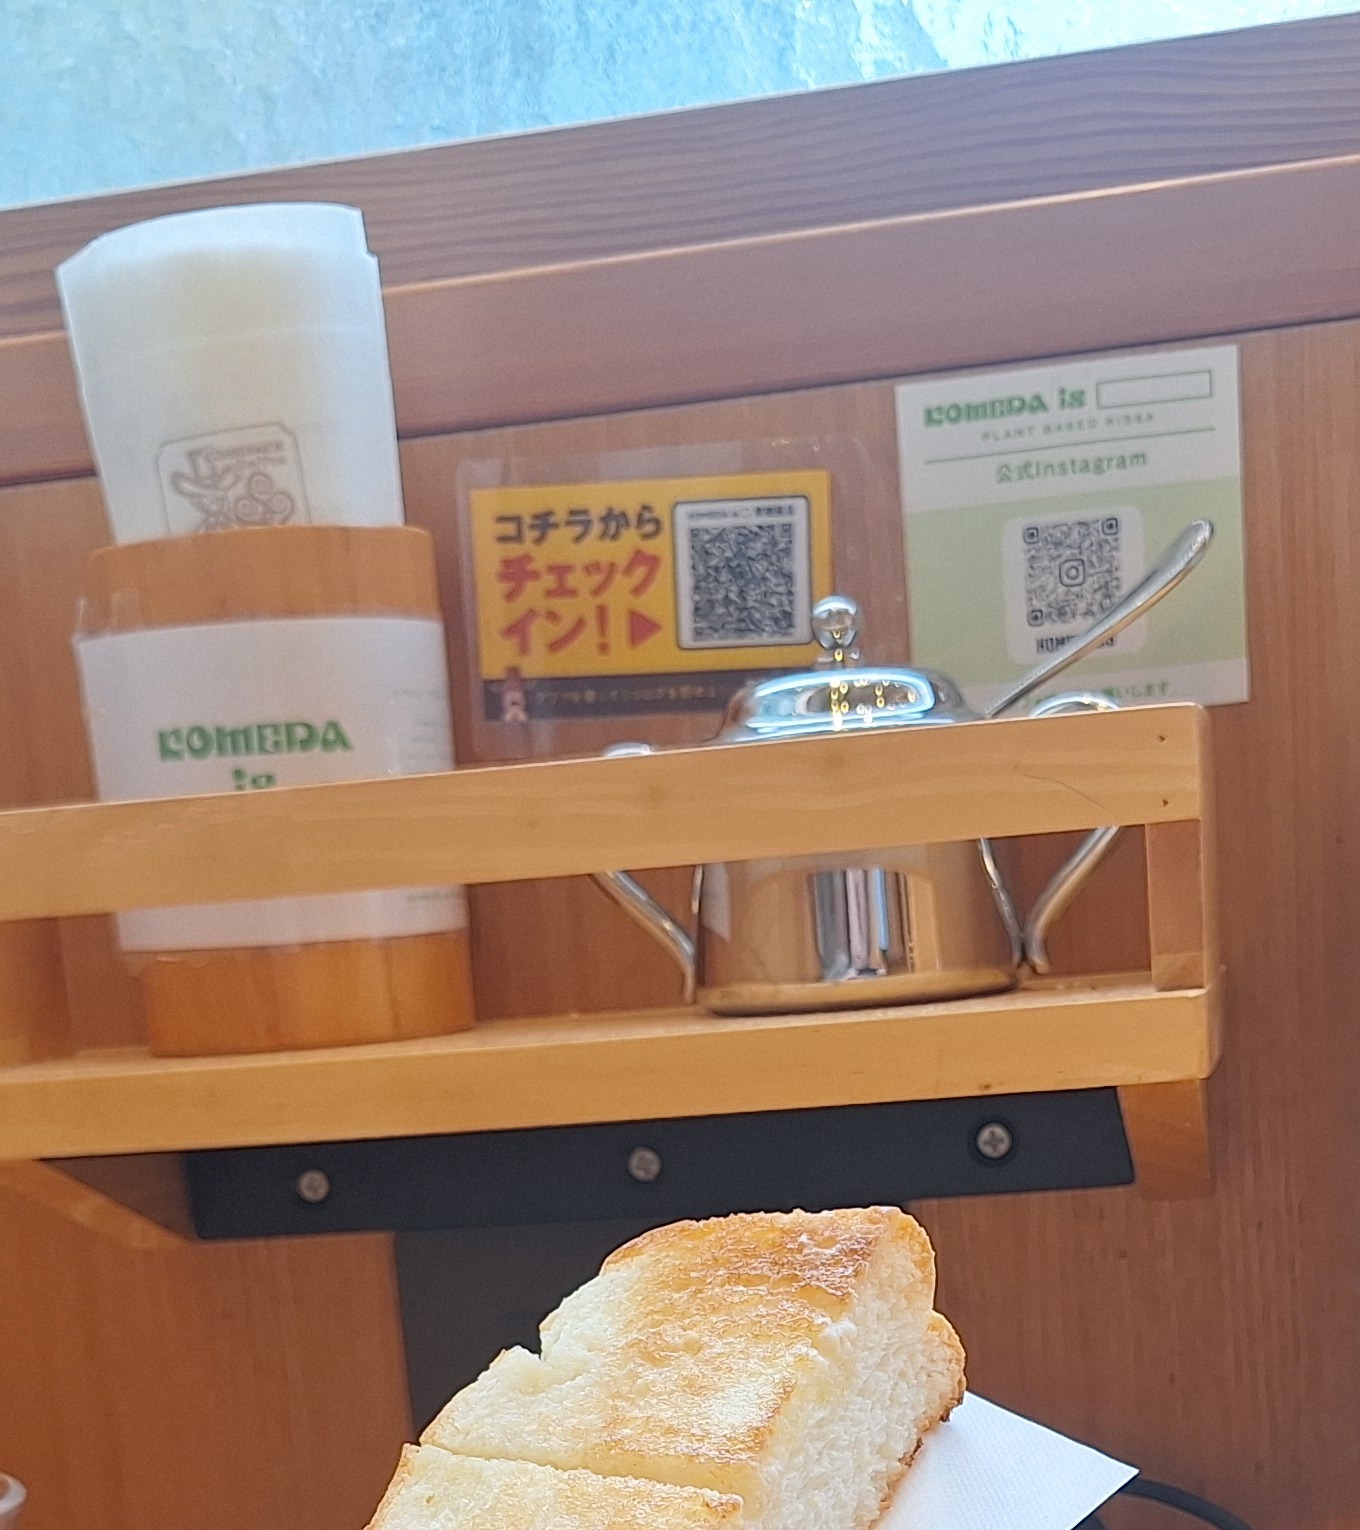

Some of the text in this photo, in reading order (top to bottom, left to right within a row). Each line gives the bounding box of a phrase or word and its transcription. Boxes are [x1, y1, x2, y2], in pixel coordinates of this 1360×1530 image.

[996, 451, 1147, 484] 公式Instagram
[495, 504, 662, 545] コチラから
[497, 549, 663, 601] チェック
[157, 719, 352, 761] KOMEDA
